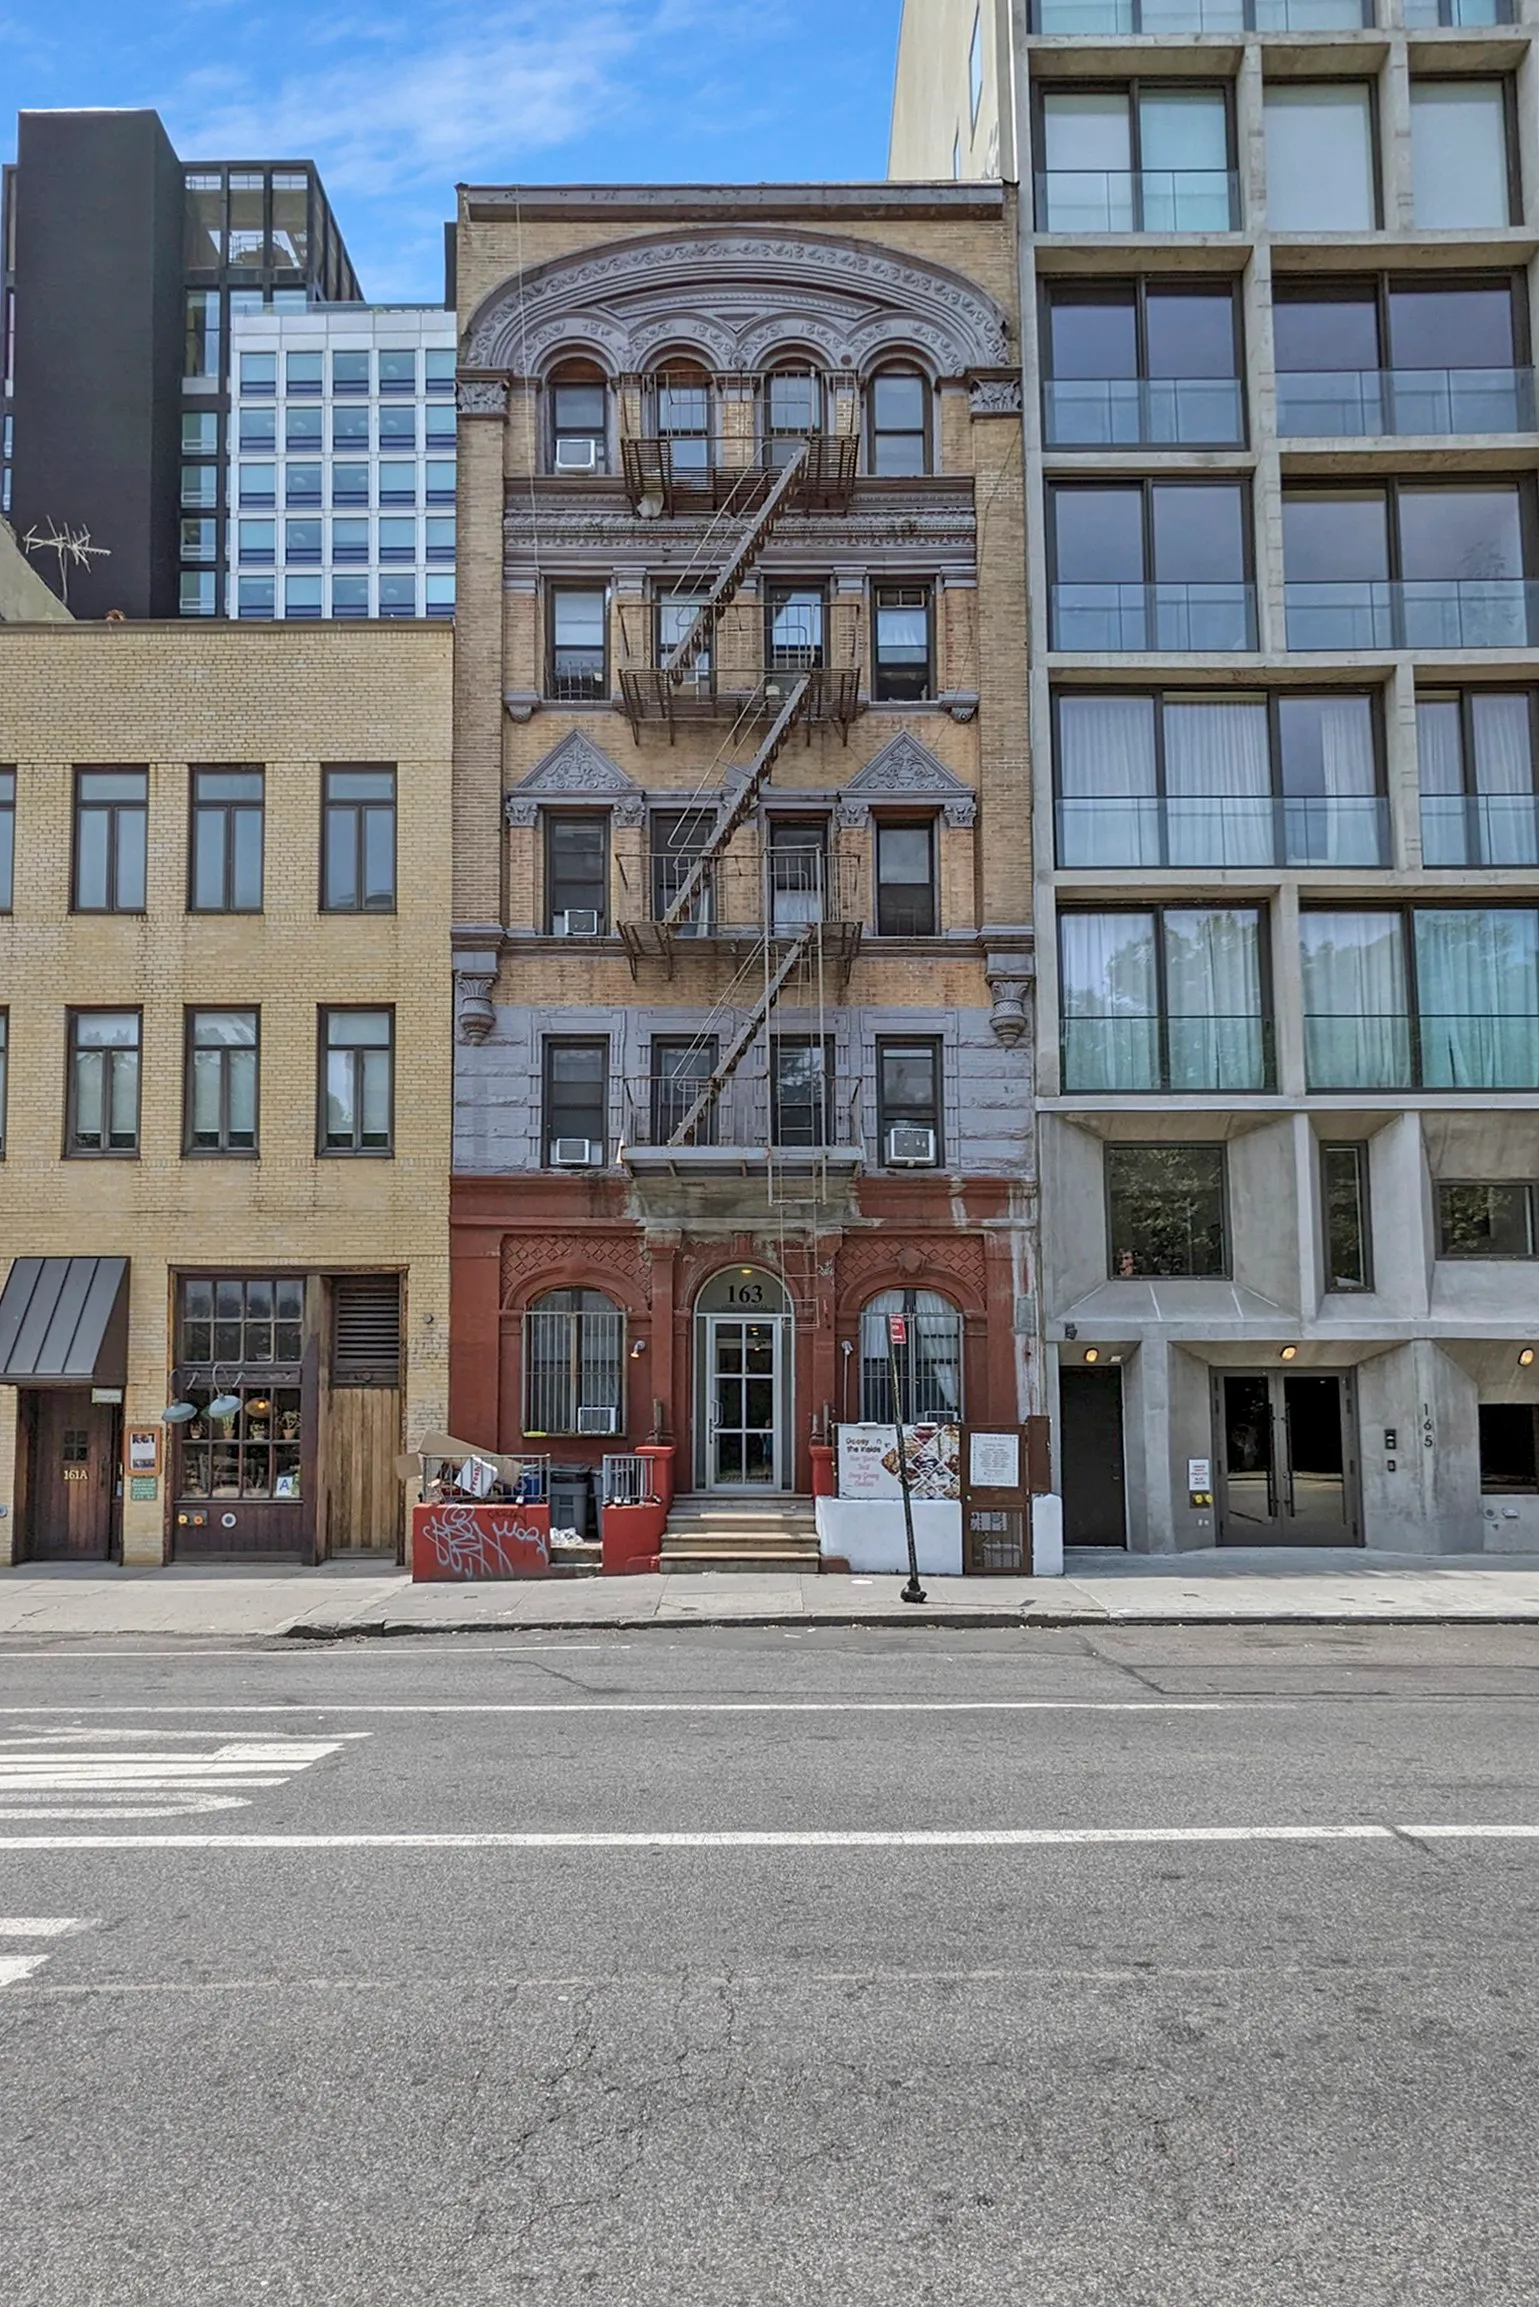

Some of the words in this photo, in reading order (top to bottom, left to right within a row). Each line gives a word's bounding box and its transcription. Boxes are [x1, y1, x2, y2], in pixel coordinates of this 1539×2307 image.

[728, 1284, 763, 1304] 163
[1423, 1403, 1433, 1447] 165
[63, 1470, 88, 1480] 161A
[279, 1479, 290, 1491] A
